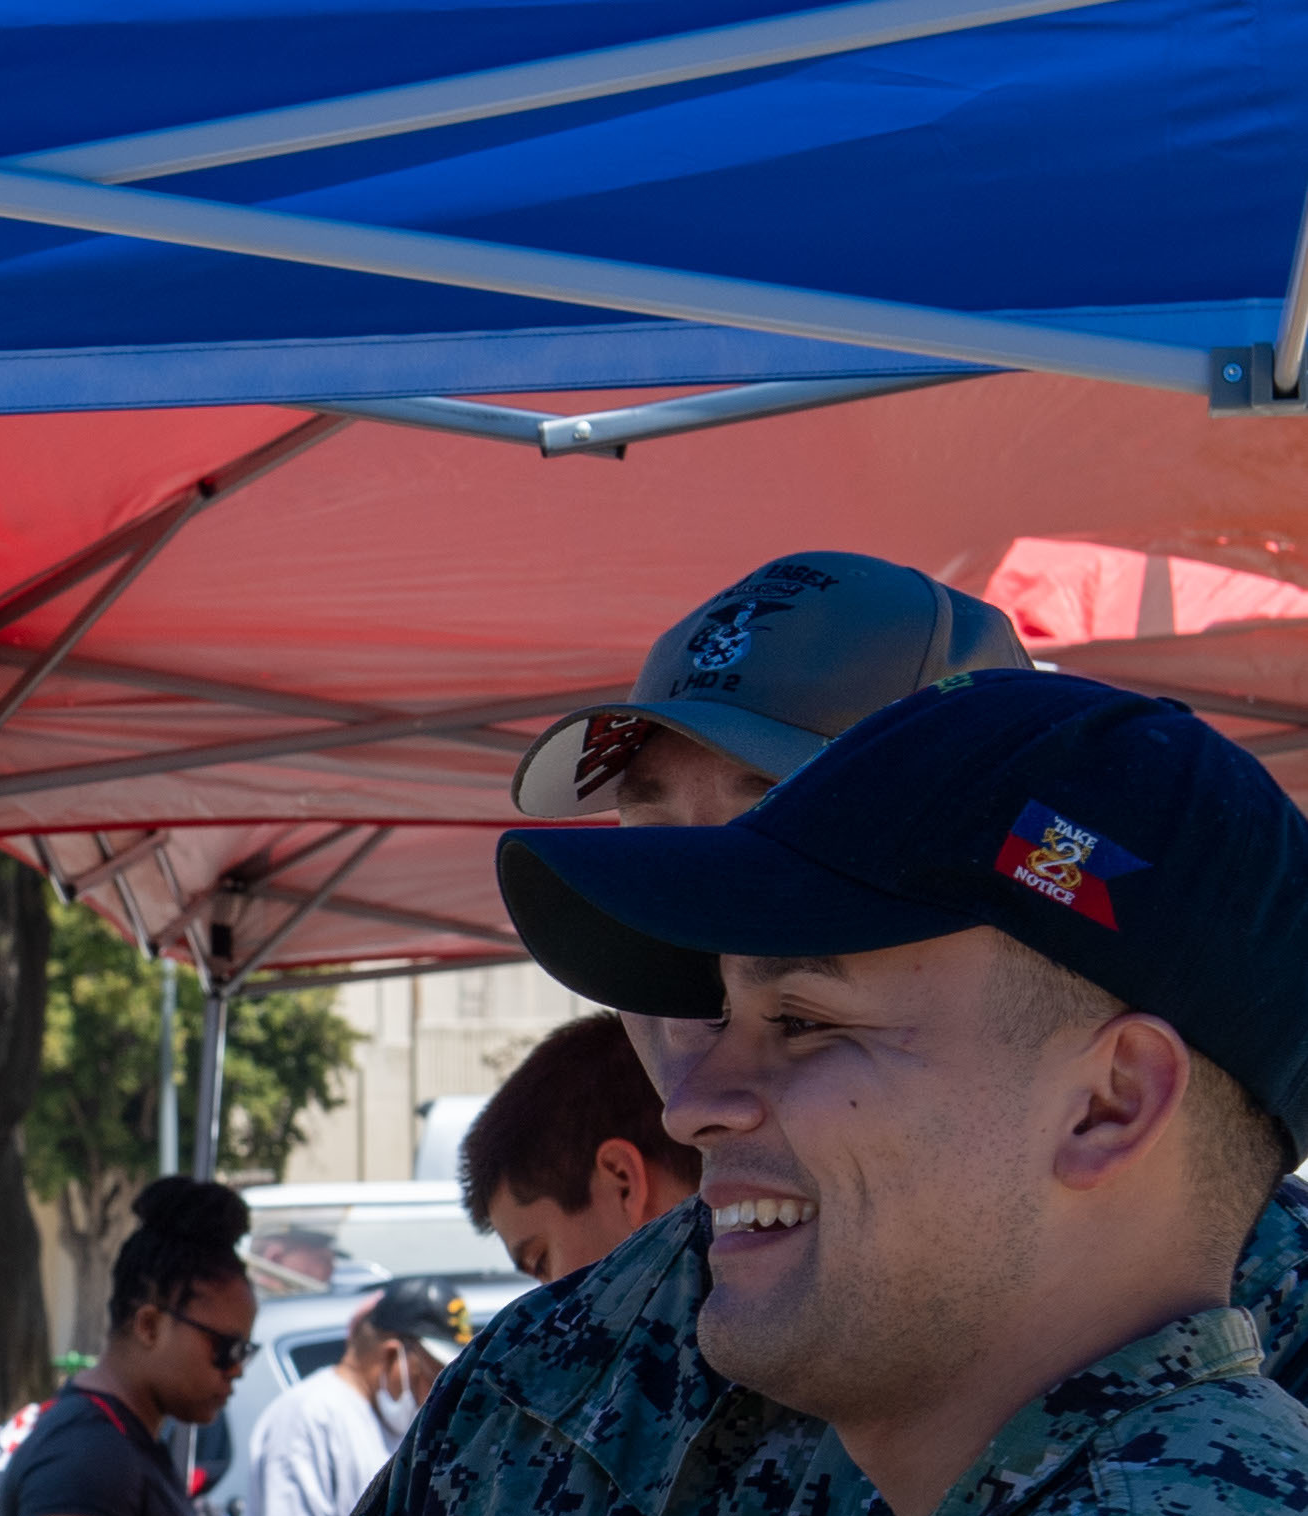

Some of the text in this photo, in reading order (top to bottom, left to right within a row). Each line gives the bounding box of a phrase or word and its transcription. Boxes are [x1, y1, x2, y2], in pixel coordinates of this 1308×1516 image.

[722, 674, 742, 693] 2
[1053, 815, 1100, 851] TAKE
[1012, 865, 1077, 906] NOTICE
